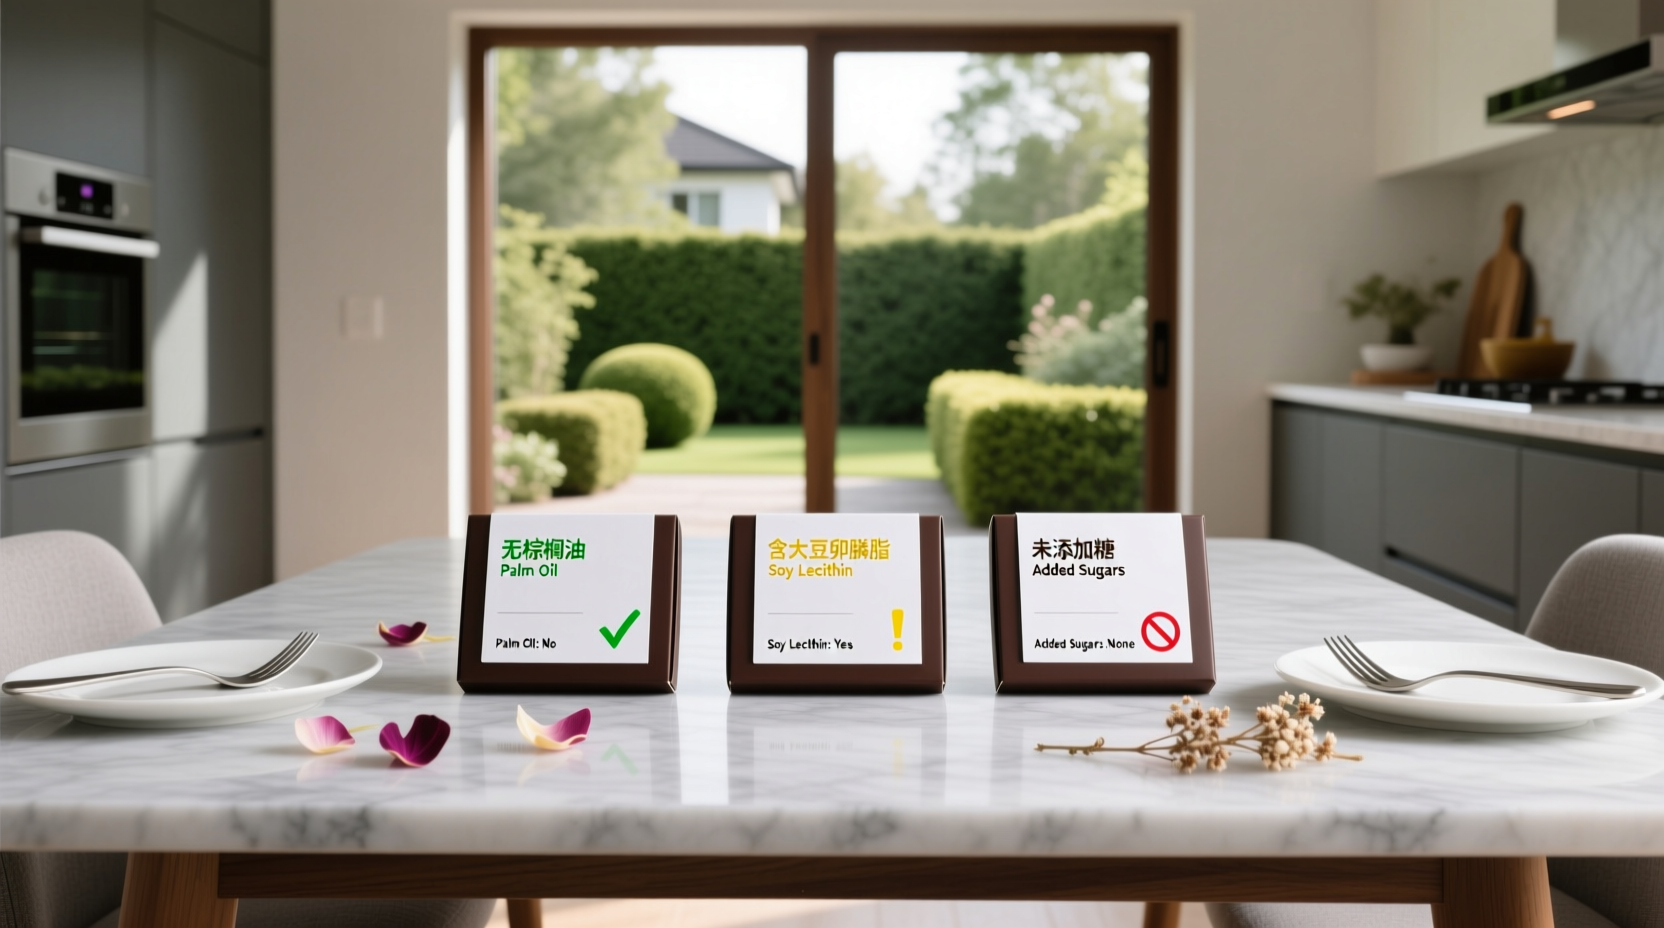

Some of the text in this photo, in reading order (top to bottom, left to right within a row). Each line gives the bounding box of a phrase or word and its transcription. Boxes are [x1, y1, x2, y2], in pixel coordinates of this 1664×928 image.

[1032, 537, 1115, 560] 未添加糖
[500, 563, 558, 577] Palm Oil
[768, 563, 853, 580] Soy Lecithin
[1032, 563, 1126, 580] Added Sugars
[495, 637, 520, 649] Palm
[542, 637, 557, 649] No
[767, 638, 786, 653] Soy
[833, 638, 854, 650] Yes
[1034, 638, 1067, 649] Added
